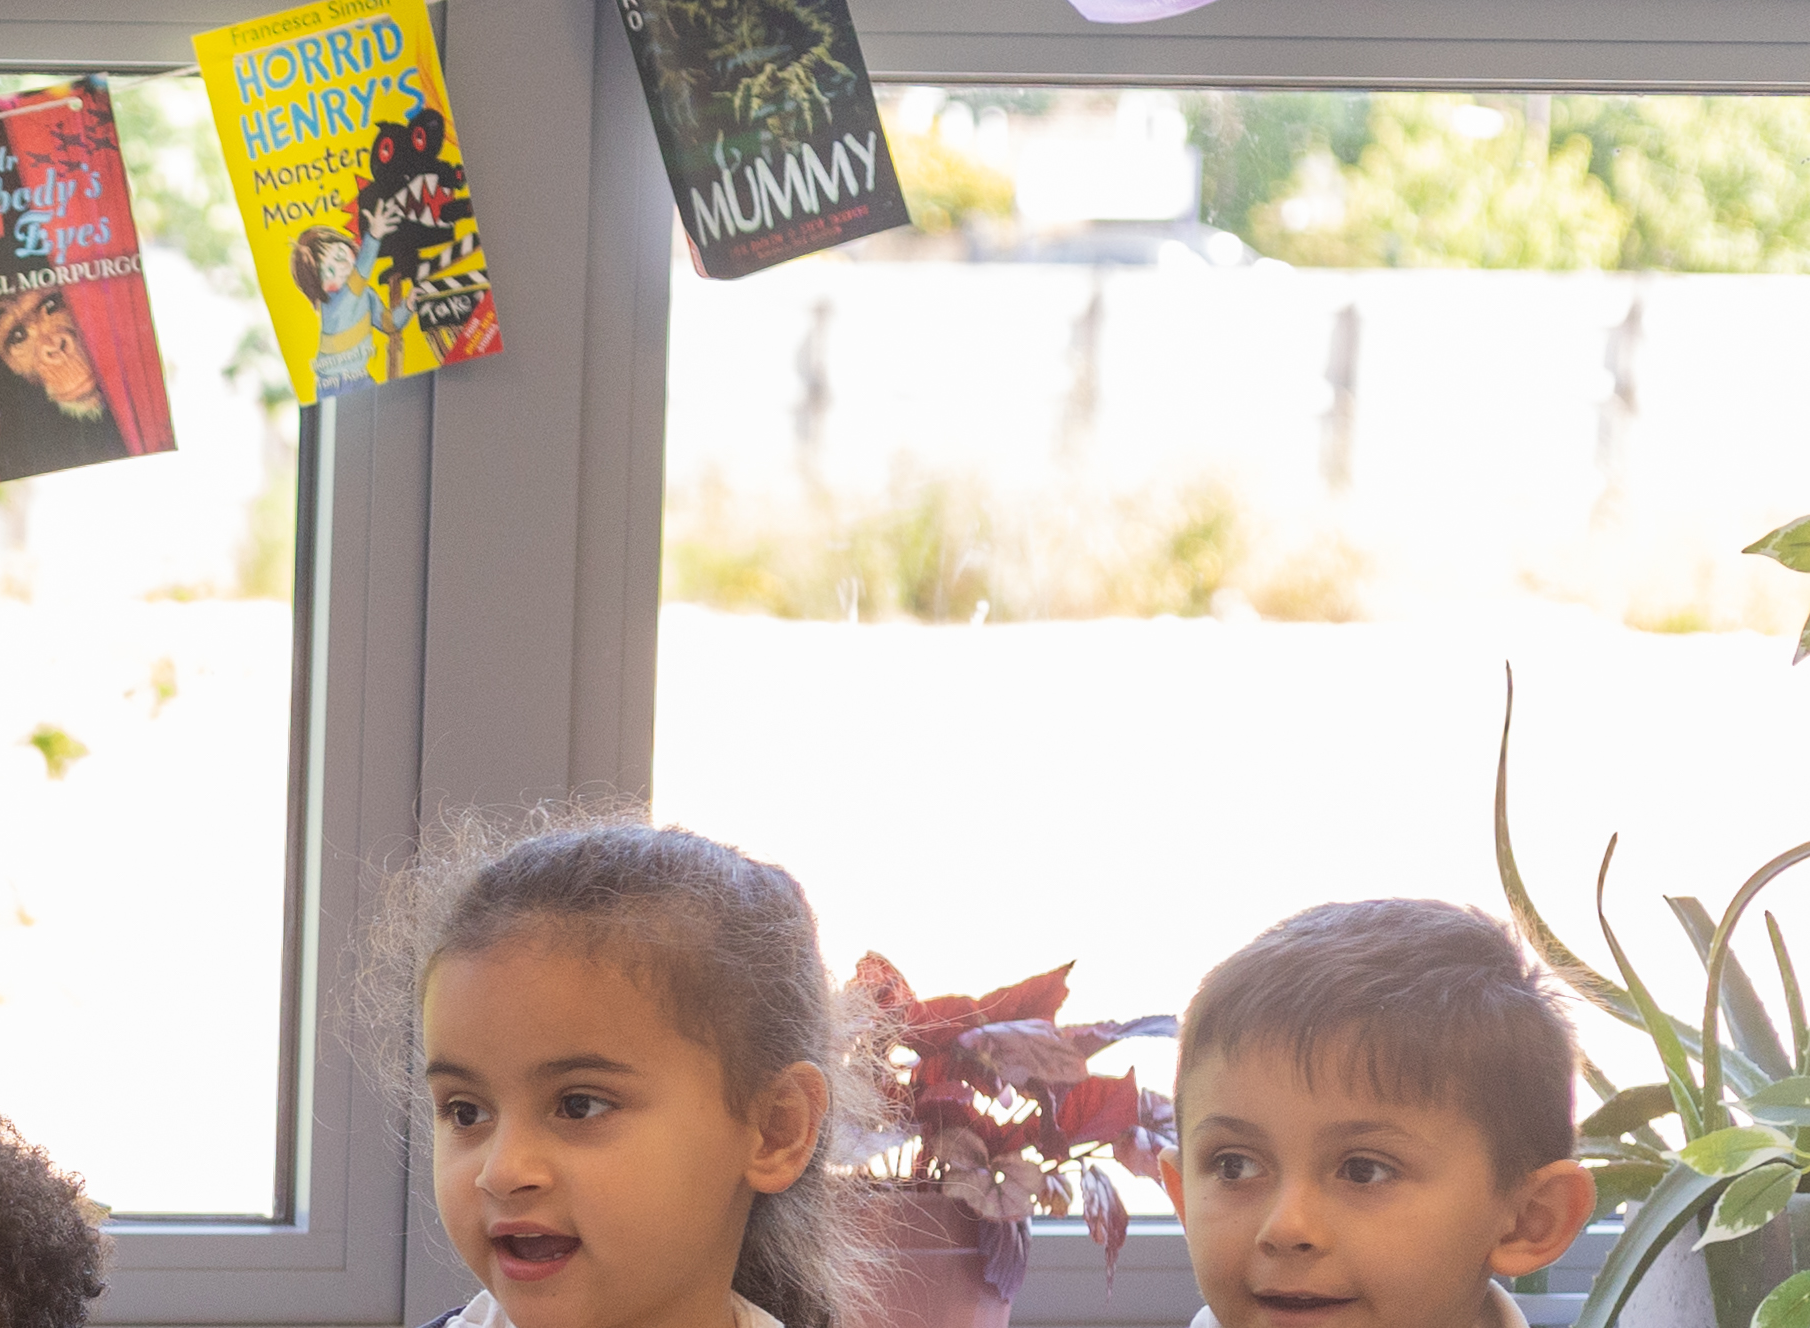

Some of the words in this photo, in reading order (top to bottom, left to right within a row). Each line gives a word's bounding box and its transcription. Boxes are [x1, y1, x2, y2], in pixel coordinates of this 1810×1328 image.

[230, 10, 322, 46] Francesca
[239, 67, 426, 161] HENRY'S
[253, 145, 371, 194] Monster
[690, 130, 877, 248] MUMMY
[262, 184, 342, 230] Movie
[13, 209, 111, 264] Eyes
